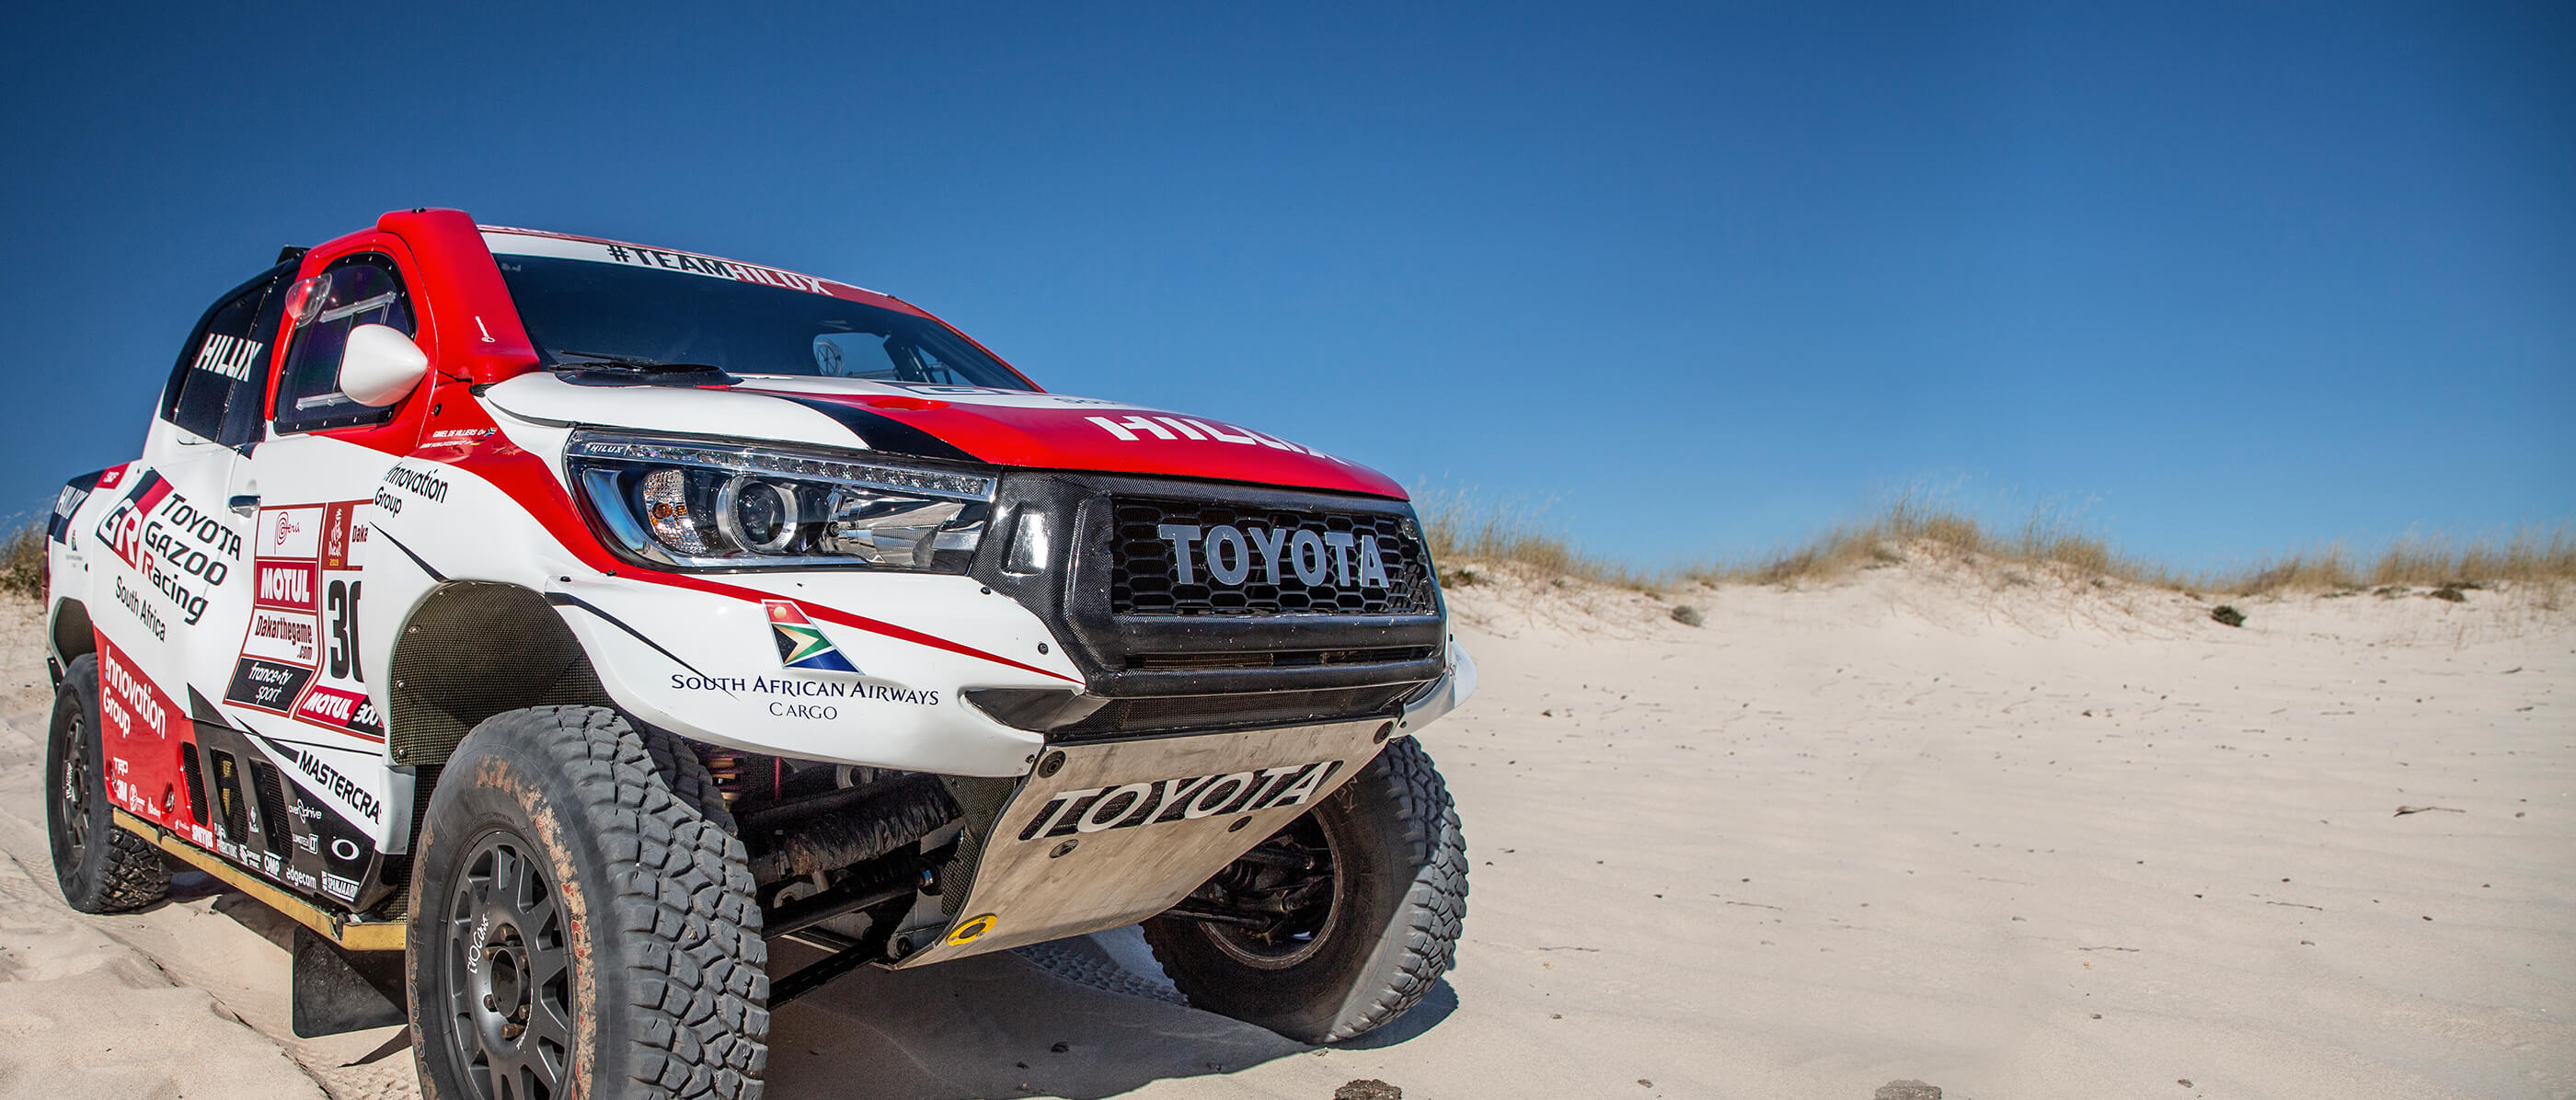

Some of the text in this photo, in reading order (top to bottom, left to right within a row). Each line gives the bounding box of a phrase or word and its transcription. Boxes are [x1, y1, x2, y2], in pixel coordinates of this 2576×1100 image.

[606, 244, 834, 296] #TEAMHILUX
[194, 332, 264, 383] HILUX
[590, 443, 625, 453] HILUX
[160, 493, 242, 562] TOYOTA
[374, 486, 403, 519] Group
[145, 521, 228, 587] GAZOO
[1157, 524, 1390, 589] TOYOTA
[115, 575, 167, 643] South Africa
[142, 550, 209, 625] Racing
[260, 567, 310, 603] MOTUL
[255, 614, 313, 646] Dakarthegame
[103, 686, 131, 739] Group
[105, 645, 167, 739] Innovation
[255, 684, 282, 705] sport
[302, 691, 353, 721] MOTUL
[671, 674, 939, 705] SOUTH AFRICAN AIRWAYS
[769, 702, 838, 721] CARGO
[298, 750, 382, 825] MASTERCRA
[1029, 760, 1336, 840] TOYOTA
[263, 854, 281, 877] OMP
[285, 864, 317, 890] edgecam
